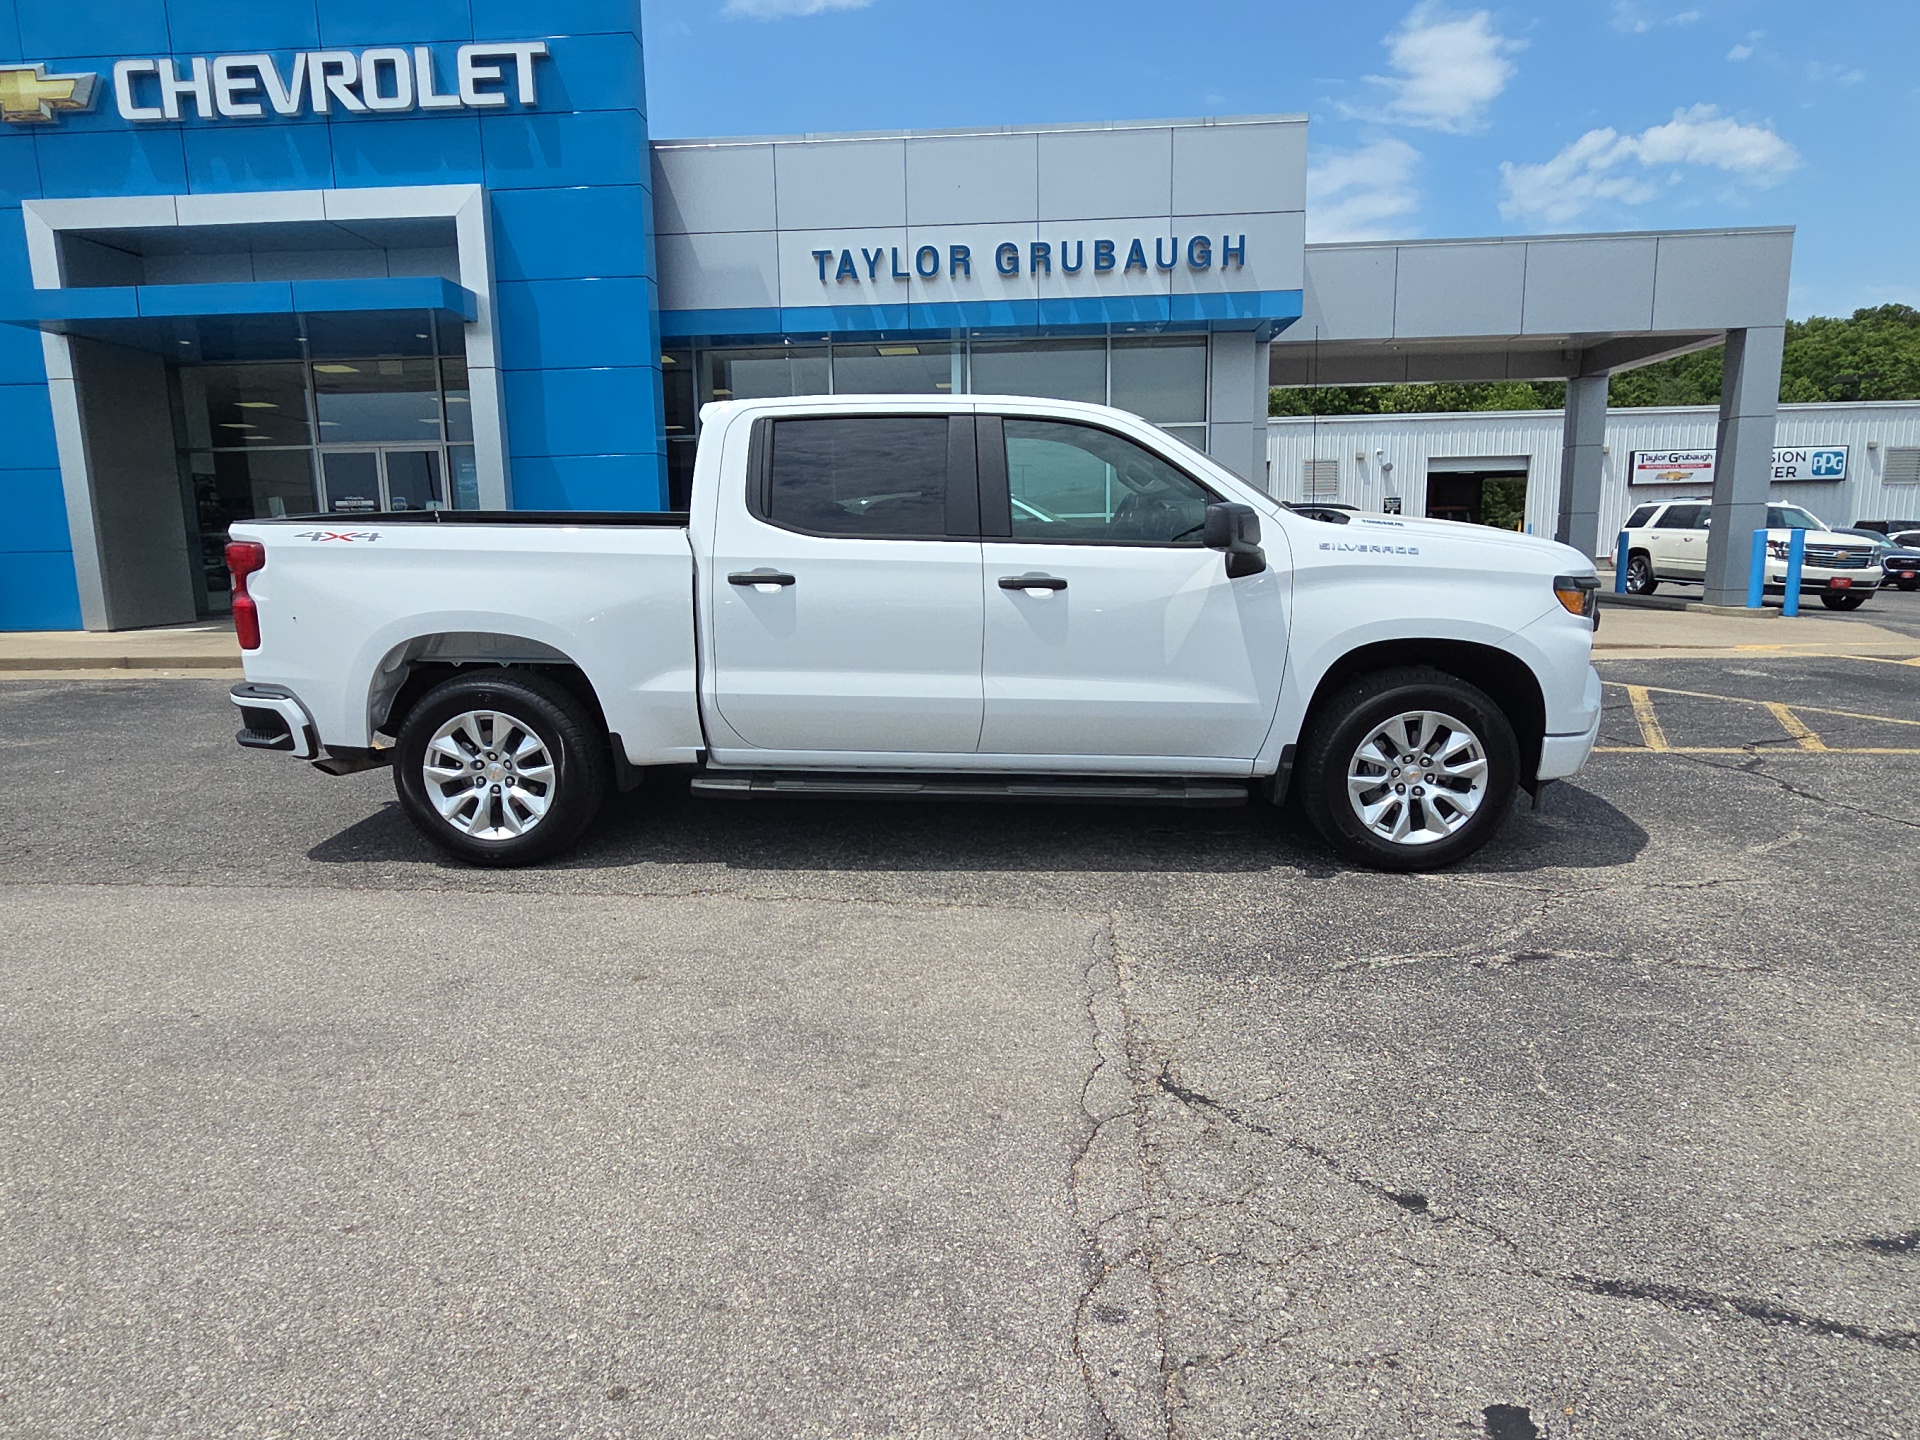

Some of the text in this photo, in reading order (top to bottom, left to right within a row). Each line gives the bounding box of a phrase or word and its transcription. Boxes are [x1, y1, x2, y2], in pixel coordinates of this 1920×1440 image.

[112, 42, 548, 121] CHEVROLET
[811, 234, 1246, 282] TAYLOR GRUBAUGH
[1638, 452, 1713, 464] Taylor Grubaugh
[1812, 453, 1844, 474] PPG
[1771, 466, 1797, 478] ER
[1318, 542, 1420, 555] SILVERADO
